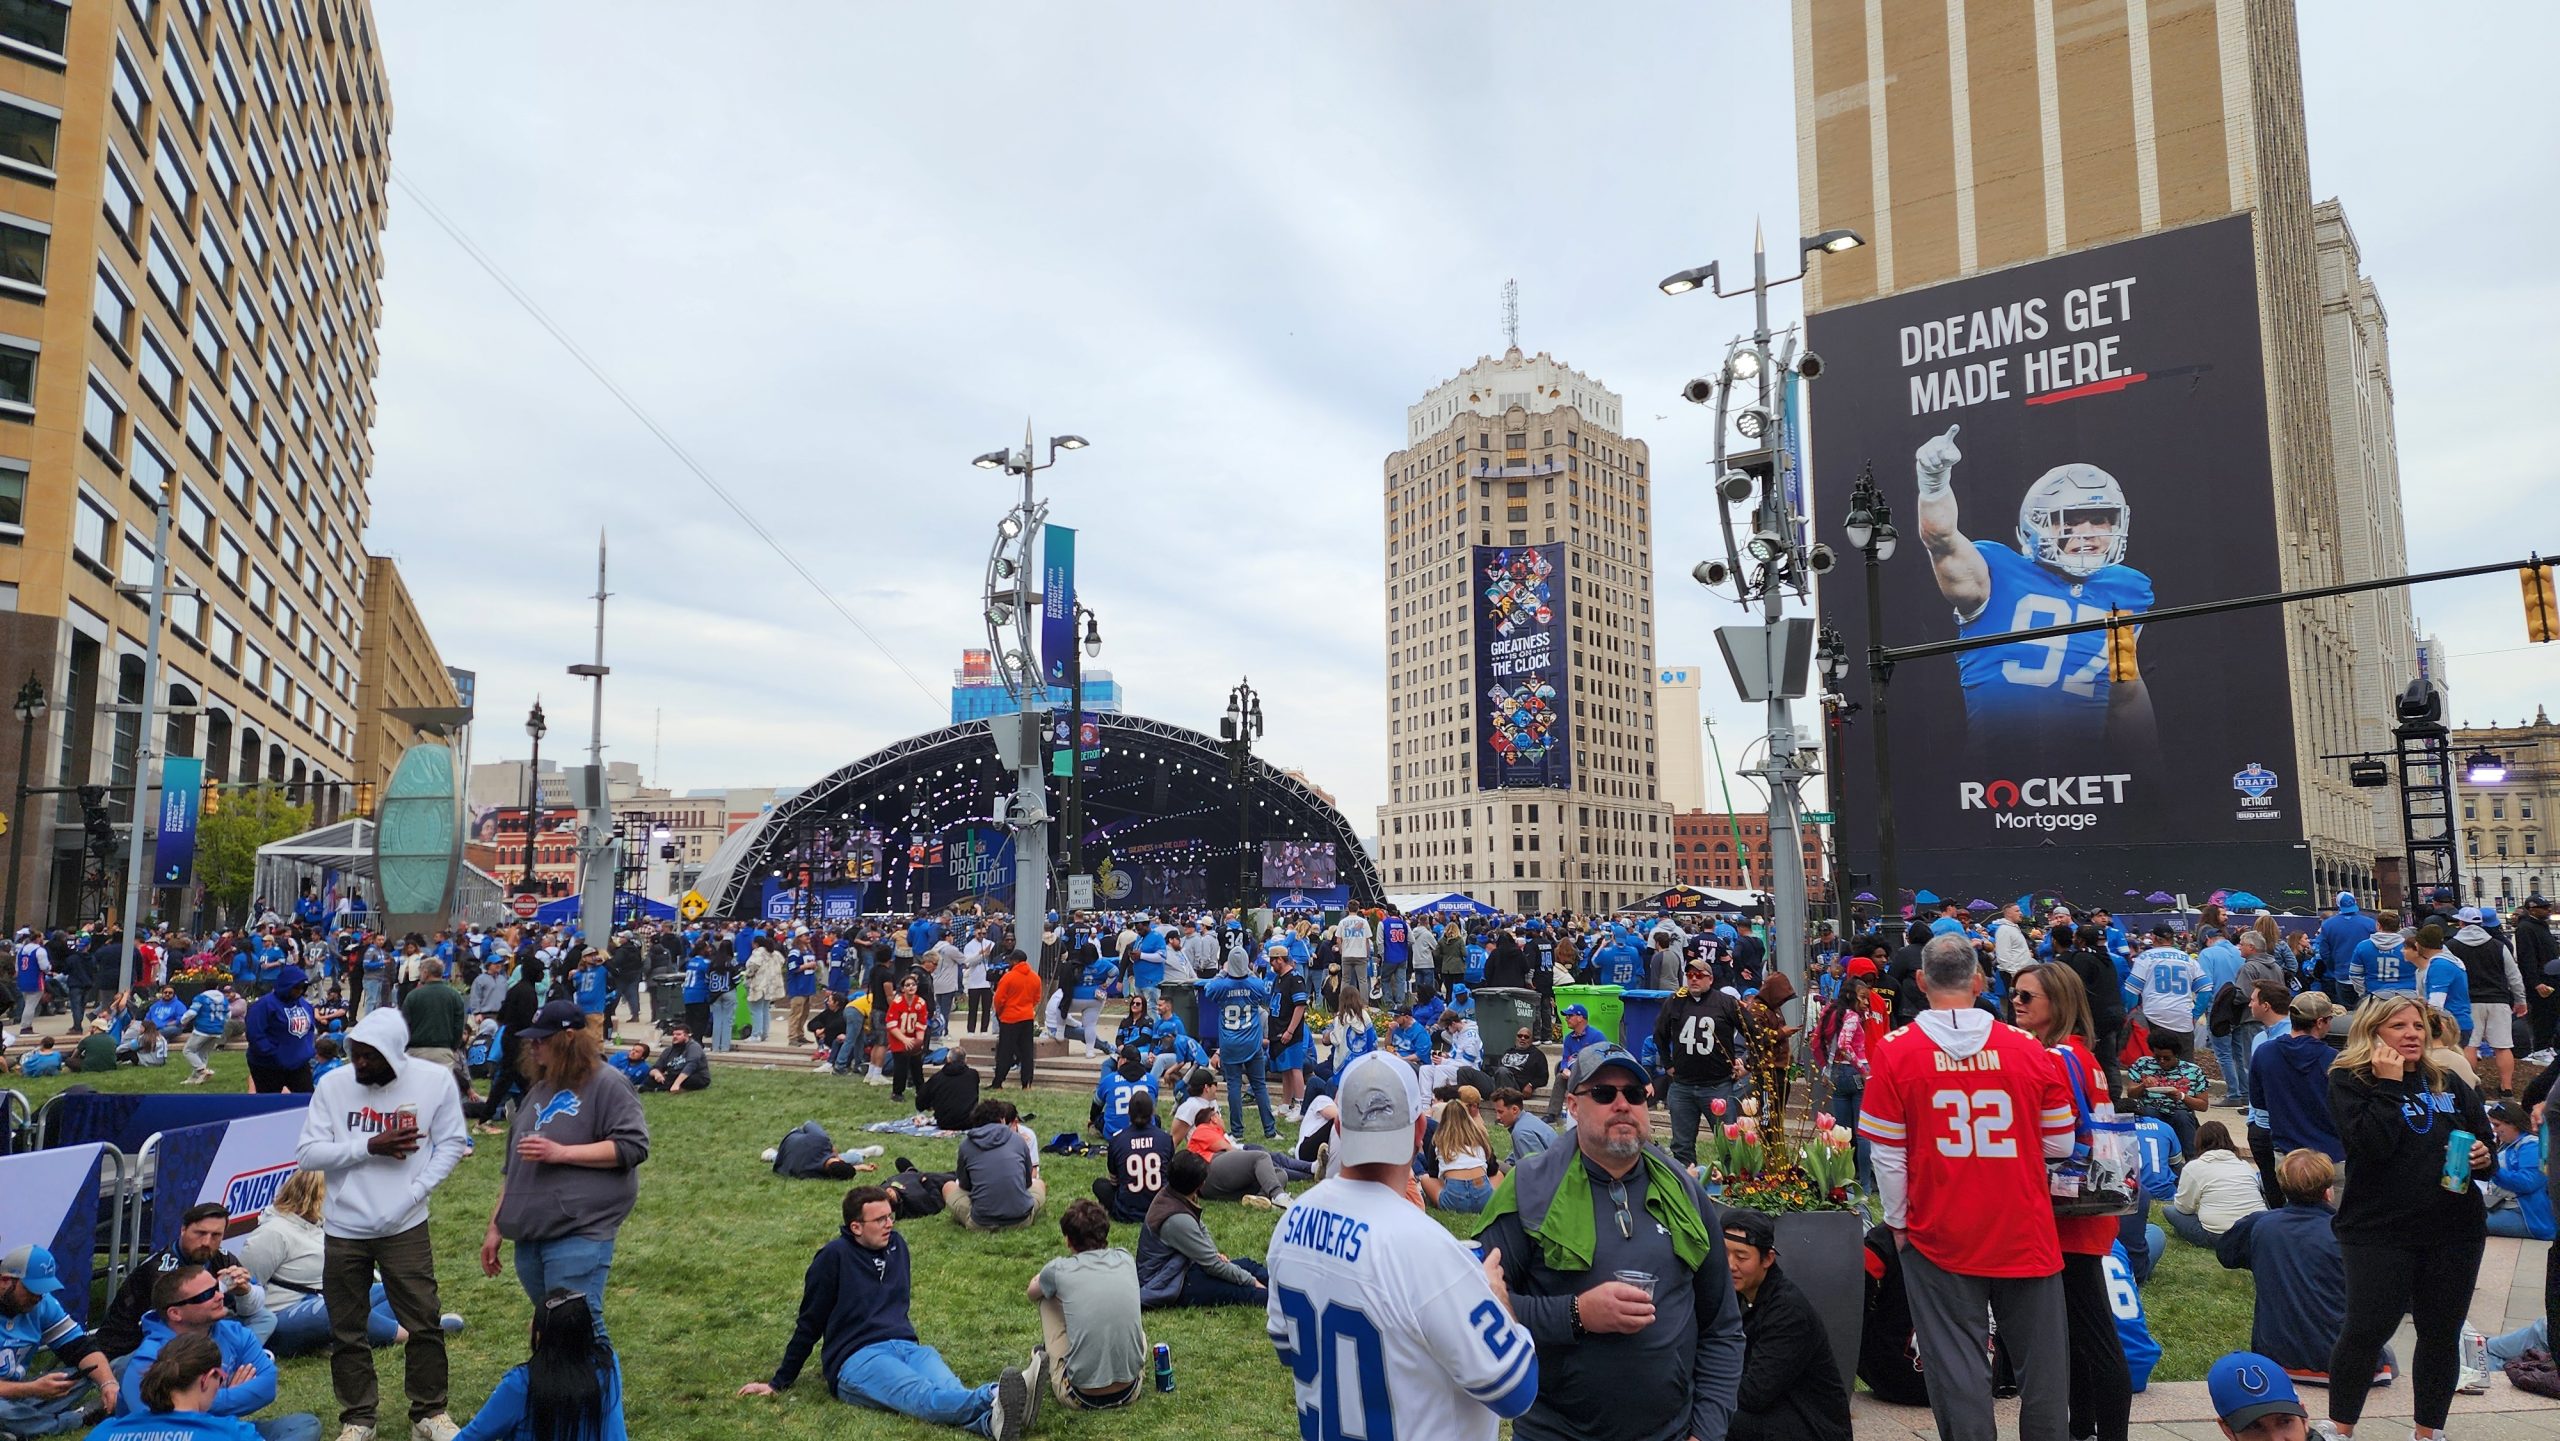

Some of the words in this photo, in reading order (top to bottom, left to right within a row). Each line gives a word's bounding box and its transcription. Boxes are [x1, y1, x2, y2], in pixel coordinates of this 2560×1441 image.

[1900, 297, 2049, 367] DREAMS
[2063, 276, 2137, 332] GET
[1910, 357, 2010, 416] MADE
[2024, 335, 2132, 394] HERE.
[1490, 632, 1551, 656] GREATNESS
[1509, 652, 1517, 660] IS
[1518, 649, 1532, 658] ON
[2001, 593, 2112, 698] 97
[1491, 660, 1513, 677] THE
[1514, 652, 1551, 673] CLOCK
[1960, 774, 2131, 810] ROCKET
[2237, 778, 2274, 786] DRAFT
[2241, 797, 2272, 807] DETROIT
[1995, 812, 2098, 831] Mortgage
[950, 841, 974, 860] NFL
[950, 854, 989, 876] DRAFT
[957, 867, 1008, 891] DETROIT
[1438, 902, 1455, 910] BUD
[1455, 902, 1474, 910] LIGHT
[1665, 894, 1681, 908] VIP
[1225, 931, 1243, 949] 34
[1697, 946, 1717, 964] 34
[709, 969, 731, 992] 81
[1613, 963, 1633, 983] 58
[2154, 964, 2188, 995] 85
[2377, 956, 2400, 982] 16
[1227, 988, 1251, 998] JOHNSON
[900, 1012, 917, 1034] 10
[1224, 1003, 1252, 1031] 81
[1516, 1007, 1534, 1018] SMART
[1679, 1015, 1715, 1056] 43
[1934, 1049, 2001, 1072] BOLTON
[1932, 1089, 2018, 1158] 32
[1130, 1137, 1153, 1149] SWEAT
[1126, 1152, 1162, 1193] 98
[227, 1168, 299, 1215] SNICK
[1284, 1206, 1369, 1262] SANDERS
[1469, 1300, 1517, 1361] 2
[1278, 1283, 1398, 1441] 20
[2477, 1349, 2488, 1379] ULTRA
